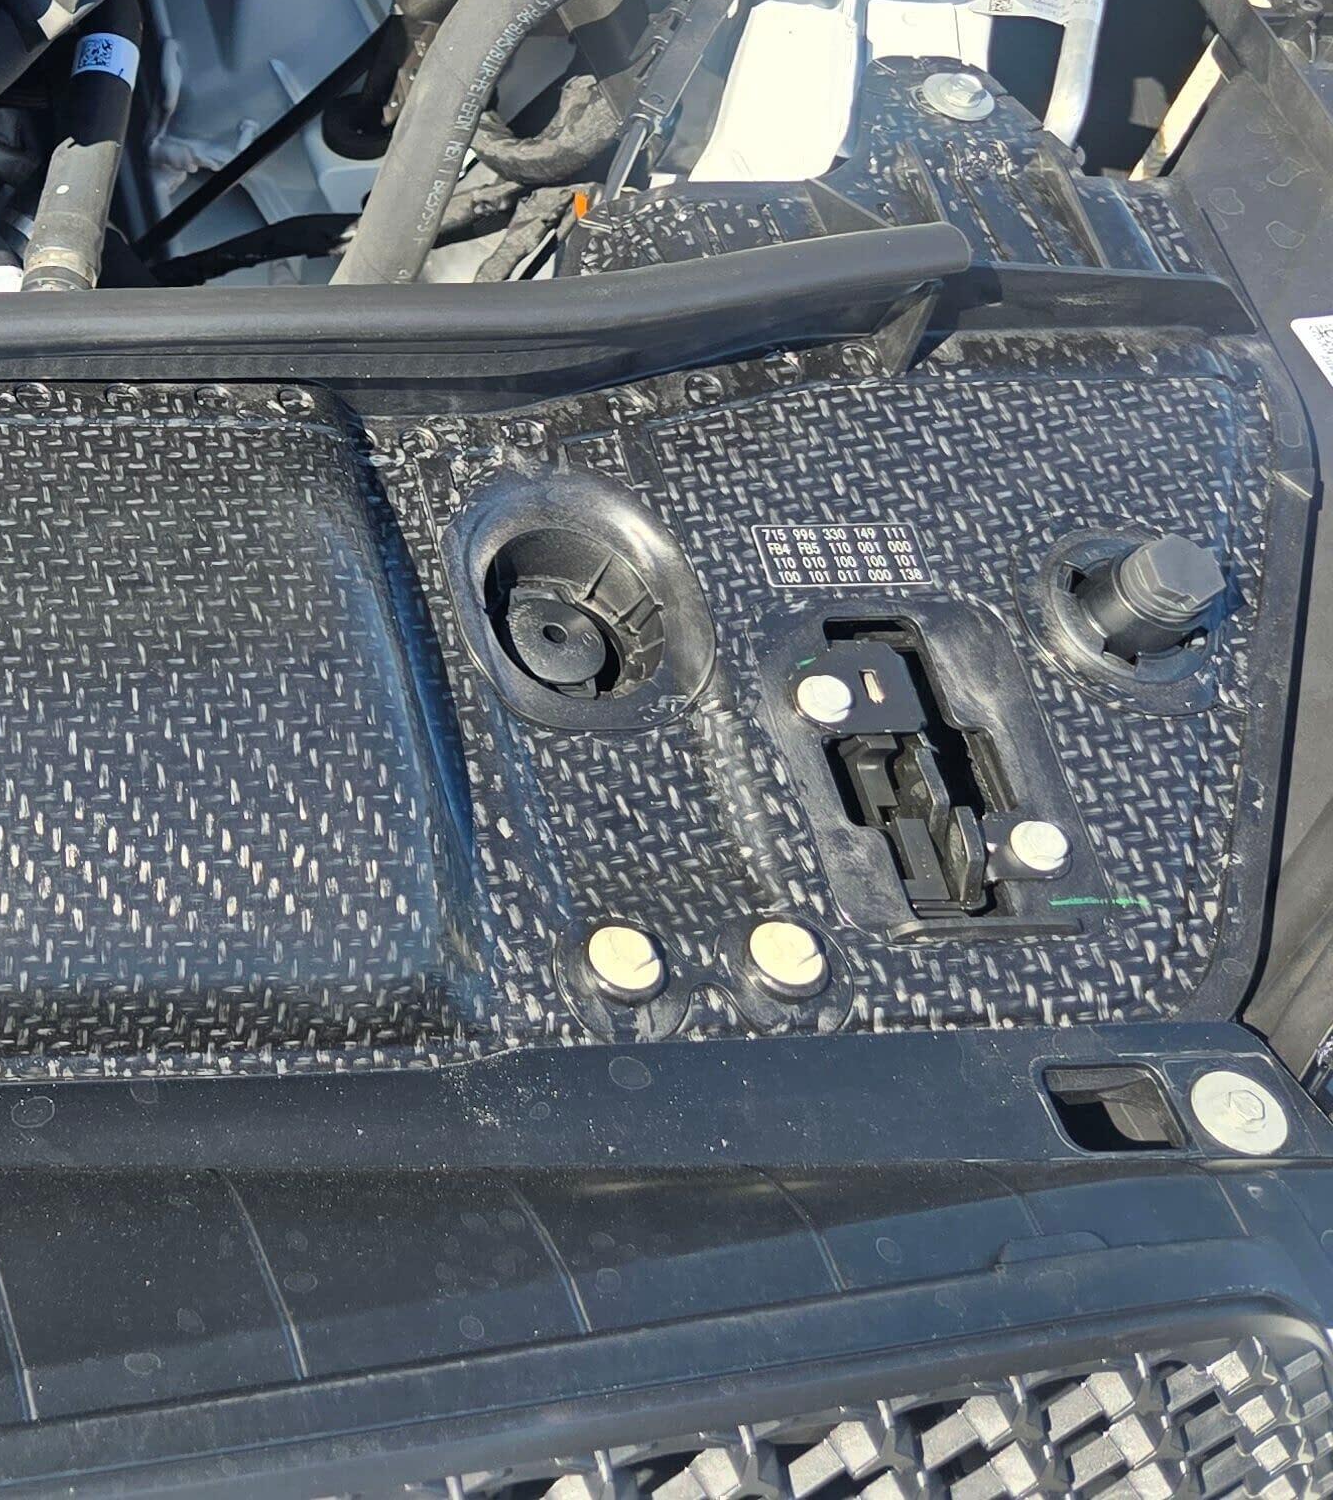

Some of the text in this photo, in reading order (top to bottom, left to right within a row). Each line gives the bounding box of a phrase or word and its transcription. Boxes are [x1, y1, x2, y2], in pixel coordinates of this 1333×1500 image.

[761, 527, 906, 541] 715 996 330 149 111
[829, 542, 851, 554] 110
[858, 542, 882, 553] 001
[888, 541, 912, 552] 000
[773, 555, 917, 569] 110 010 100 100 101
[779, 571, 801, 583] 100
[809, 570, 831, 583] 101
[838, 570, 861, 582] 011
[868, 569, 892, 581] 000
